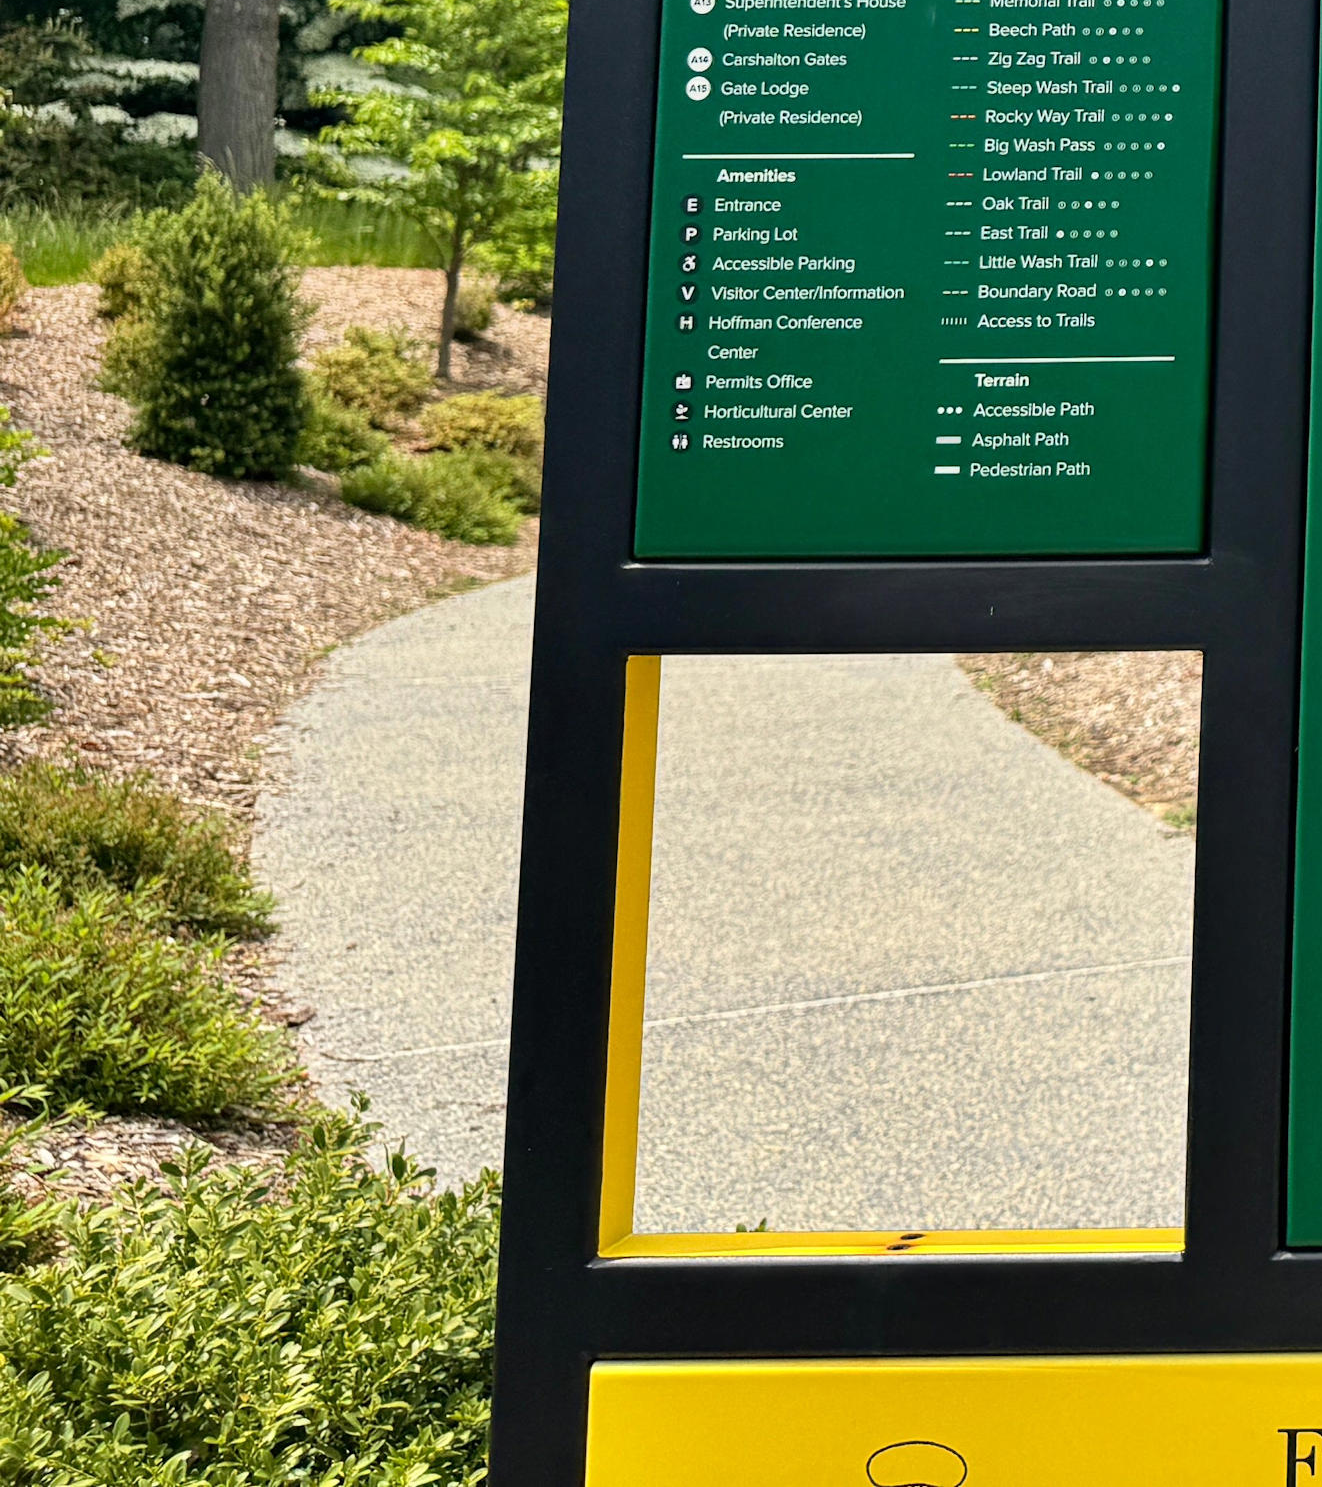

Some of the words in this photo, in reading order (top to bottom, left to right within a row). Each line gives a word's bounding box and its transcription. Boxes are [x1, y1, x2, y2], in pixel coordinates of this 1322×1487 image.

[722, 52, 801, 67] Carshalton
[803, 52, 848, 67] Gates
[720, 81, 758, 96] Gate
[760, 81, 810, 99] Lodge
[719, 110, 776, 128] (Private
[779, 109, 863, 127] Residence)
[985, 109, 1034, 127] Rocky
[1036, 109, 1071, 126] Way
[1073, 108, 1105, 123] Trail
[716, 168, 797, 183] Amenities
[714, 197, 782, 212] Entrance
[712, 226, 771, 245] Parking
[774, 226, 798, 242] Lot
[711, 256, 795, 271] Accessible
[798, 255, 856, 274] Parking
[979, 255, 1017, 270] Little
[1020, 254, 1063, 269] Wash
[1066, 254, 1099, 268] Trail
[711, 286, 760, 301] Visitor
[762, 285, 905, 301] Center/Information
[977, 284, 1054, 302] Boundary
[1057, 283, 1097, 298] Road
[708, 315, 773, 330] Hoffman
[775, 314, 863, 330] Conference
[976, 313, 1033, 329] Access
[1035, 314, 1052, 328] to
[1055, 312, 1096, 328] Trails
[707, 344, 759, 360] Center
[974, 372, 1030, 388] Terrain
[702, 434, 784, 449] Restrooms
[971, 432, 1031, 450] Asphalt
[1034, 432, 1069, 447] Path
